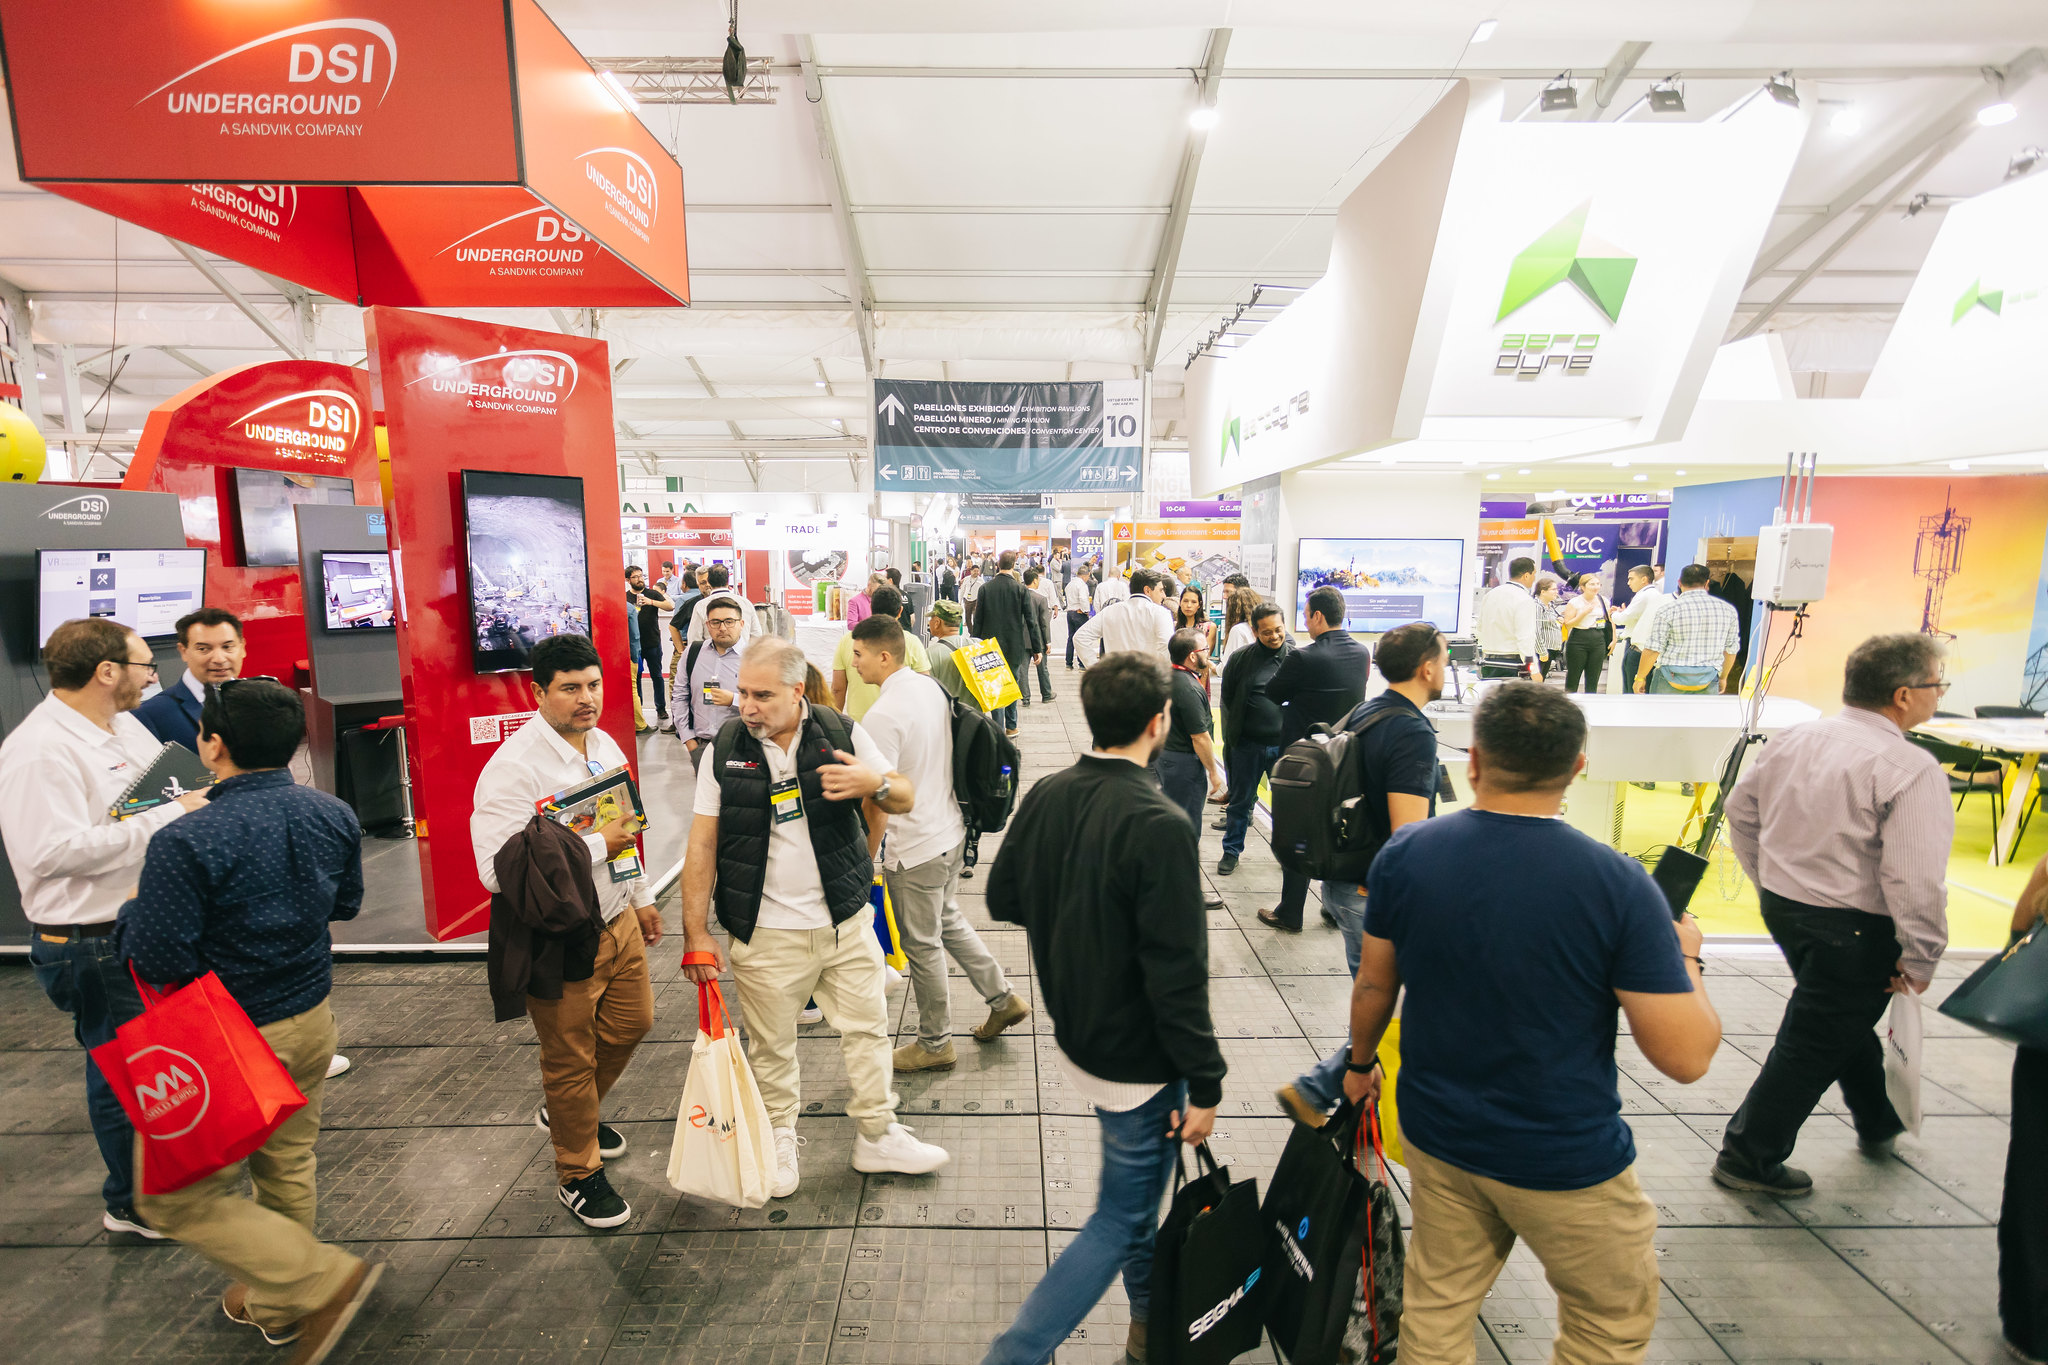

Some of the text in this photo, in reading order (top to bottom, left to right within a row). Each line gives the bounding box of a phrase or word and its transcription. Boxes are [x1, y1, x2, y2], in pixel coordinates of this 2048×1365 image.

[289, 43, 374, 83] DSI
[168, 93, 361, 115] UNDERGROUND
[220, 123, 363, 136] A SANDVIK COMPANY
[238, 185, 284, 208] SI
[586, 161, 649, 228] UNDERGROUND
[626, 162, 652, 209] DSI
[184, 185, 279, 226] ERGROUND
[191, 197, 280, 243] A SANDVIK COMPANY
[536, 217, 591, 241] DS
[456, 249, 583, 262] UNDERGROUND
[489, 267, 584, 276] A SANDVIK COMPANY
[1501, 334, 1600, 348] aero
[1496, 349, 1593, 374] dyne
[512, 359, 565, 387] DSI
[433, 379, 557, 403] UNDERGROUND
[309, 401, 350, 433] DSI
[467, 400, 558, 415] A SANDVIK COMPANY
[913, 404, 967, 412] PABELLONES
[968, 404, 1015, 412] EXHIBICIÓN
[913, 414, 957, 423] PABELLÓN
[962, 427, 1027, 435] CONVENCIONES
[1107, 415, 1137, 437] 10
[245, 423, 346, 452] UNDERGROUND
[80, 500, 103, 512] DSI
[1044, 496, 1053, 505] 11
[667, 532, 701, 540] CORESA
[785, 525, 820, 534] TRADE
[47, 558, 60, 566] VR
